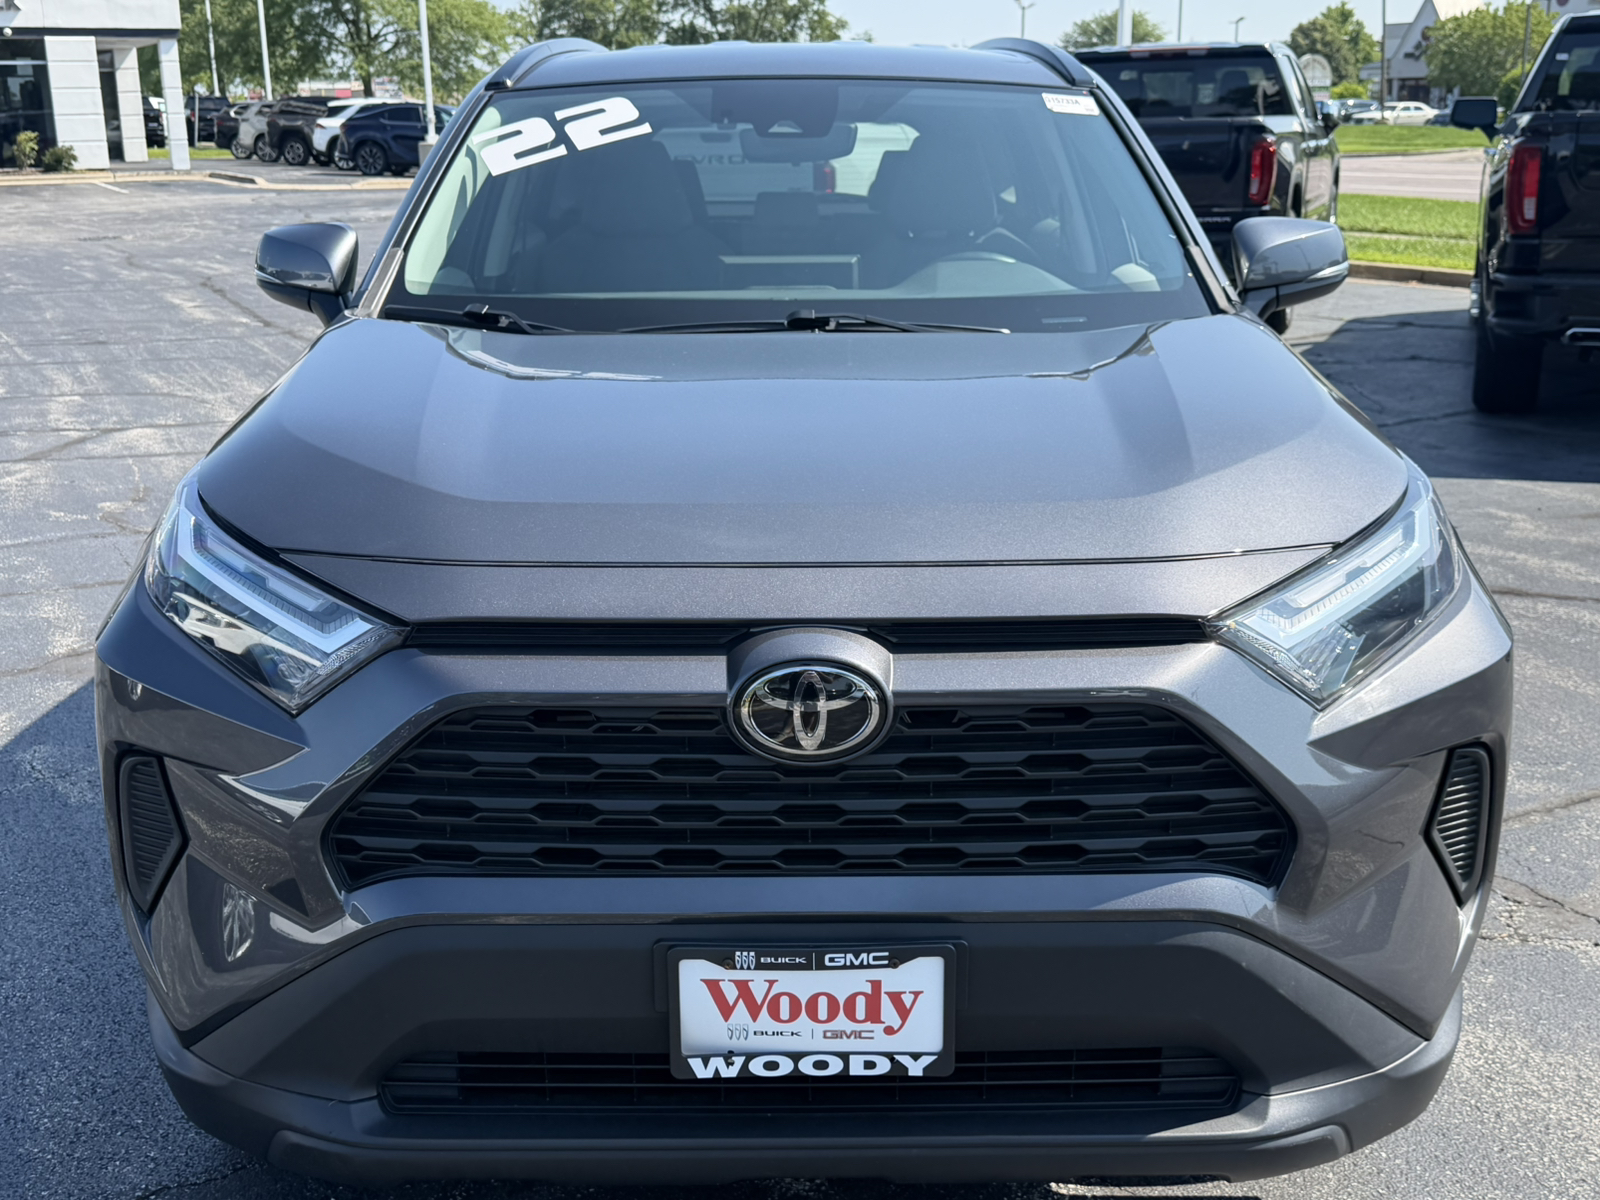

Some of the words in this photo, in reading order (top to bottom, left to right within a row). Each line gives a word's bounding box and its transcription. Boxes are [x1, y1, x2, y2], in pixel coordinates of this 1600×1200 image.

[471, 96, 652, 177] 22
[760, 956, 807, 964] BUICK
[824, 951, 889, 967] GMC
[699, 978, 924, 1037] Woody
[753, 1029, 802, 1038] BUICK
[822, 1029, 875, 1040] GMC
[686, 1053, 939, 1079] WOODY
